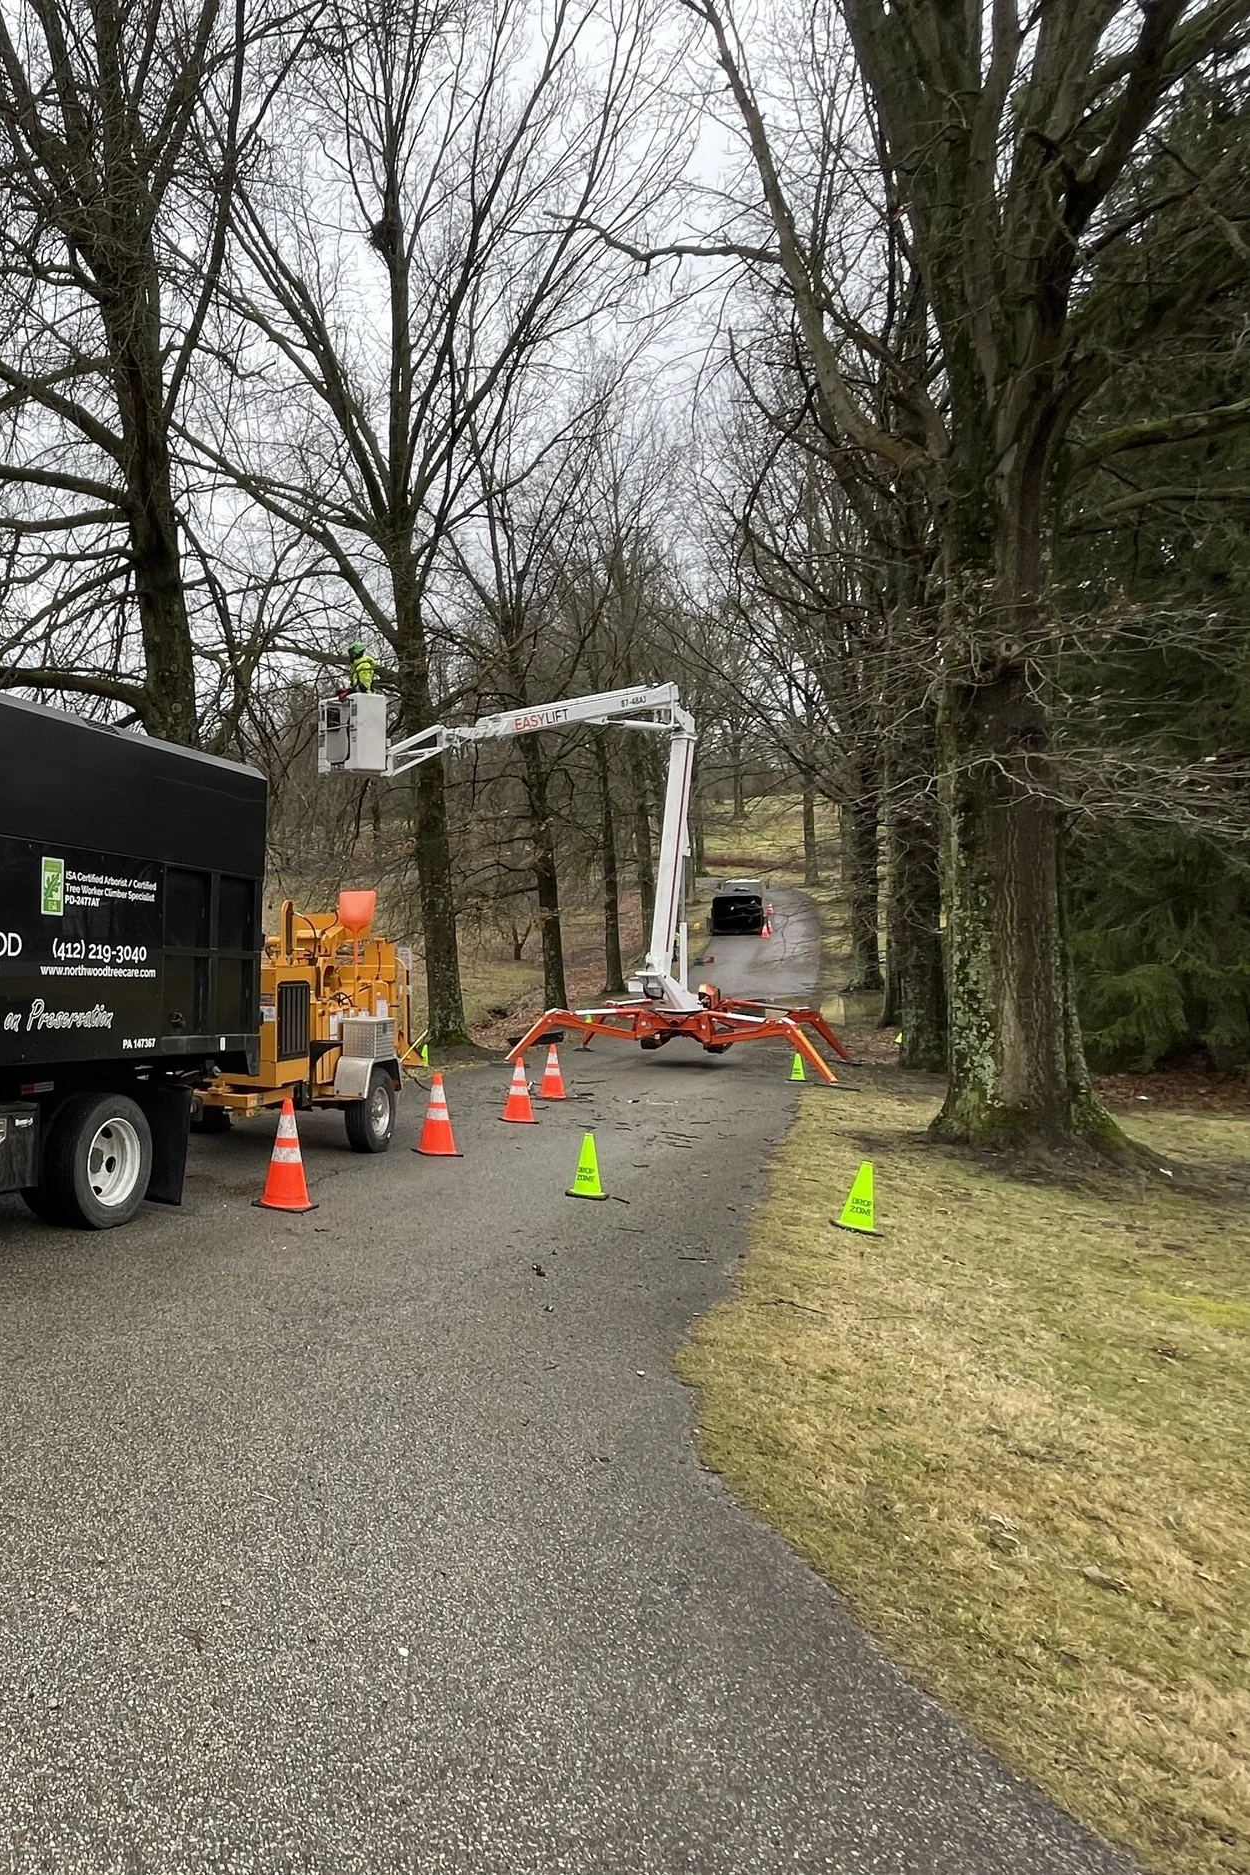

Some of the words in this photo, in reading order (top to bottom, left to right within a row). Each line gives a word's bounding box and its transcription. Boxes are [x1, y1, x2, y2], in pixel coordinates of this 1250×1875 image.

[514, 709, 568, 730] EASYLIFT
[65, 871, 77, 881] ISA
[77, 872, 104, 885] Certified
[104, 876, 128, 888] Arborist
[133, 880, 157, 891] Certified
[65, 883, 81, 894] Tree
[81, 885, 104, 897] Worker
[104, 888, 128, 899] Climber
[128, 891, 156, 902] Specialist
[53, 937, 85, 961] (412)
[88, 943, 147, 963] 219-3040
[40, 964, 156, 978] www.northwoodtreecare.com
[3, 1012, 22, 1032] on
[26, 998, 114, 1032] Preservation
[122, 1038, 133, 1049] PA
